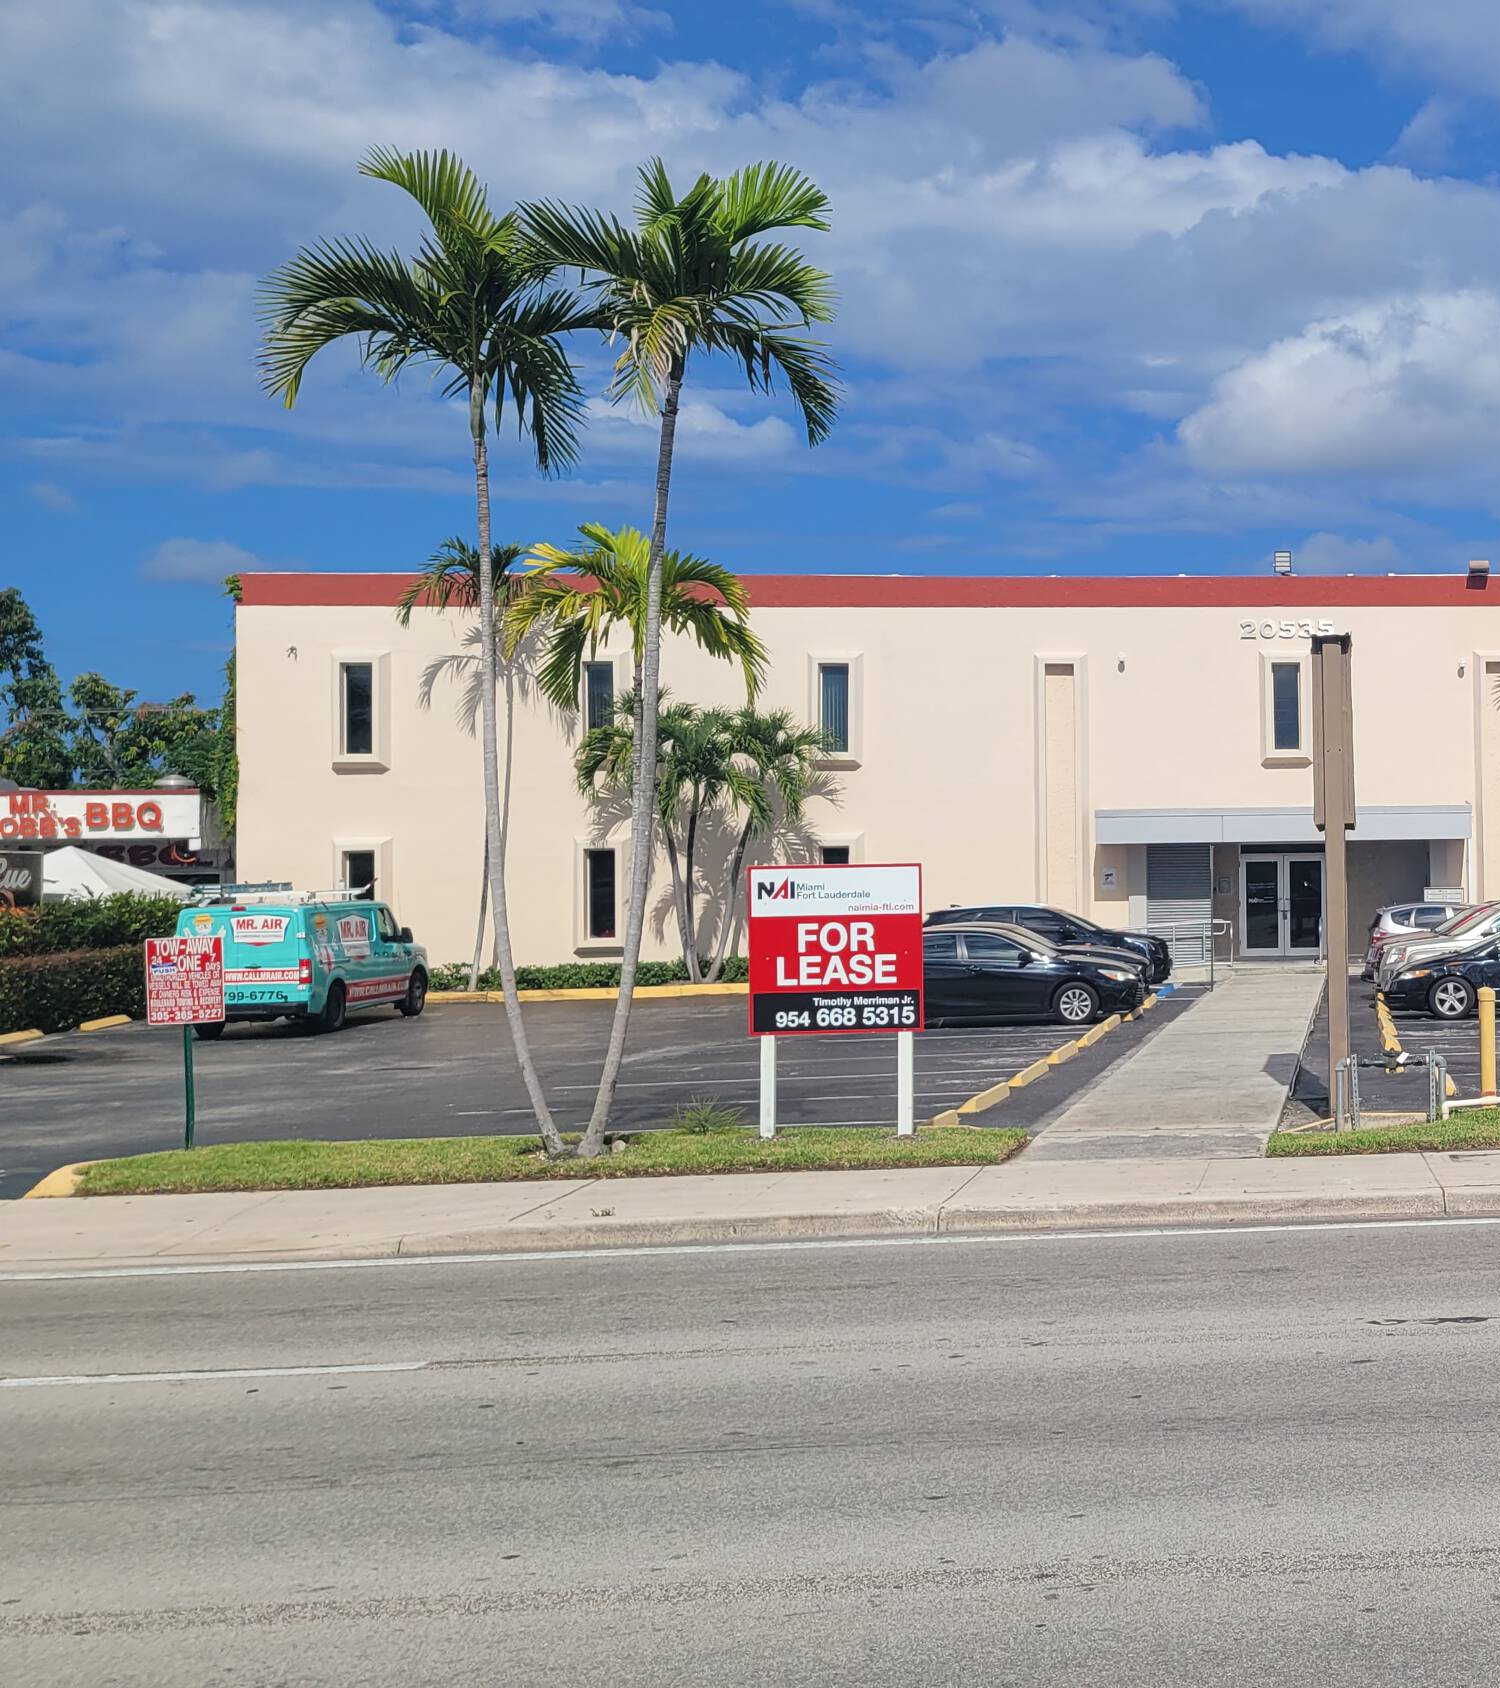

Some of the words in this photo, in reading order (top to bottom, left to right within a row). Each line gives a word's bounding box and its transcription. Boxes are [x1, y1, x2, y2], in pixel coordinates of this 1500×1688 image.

[1239, 618, 1335, 640] 20535
[86, 801, 164, 832] BBQ
[757, 876, 795, 899] NAI
[796, 883, 825, 891] Miami
[796, 891, 817, 899] Fort
[818, 890, 871, 899] Lauderdale
[848, 903, 914, 912] naimia-ftl.com
[236, 918, 257, 930] MR.
[261, 918, 283, 930] AIR
[154, 938, 214, 956] TOW-AWAY
[797, 922, 875, 953] FOR
[776, 954, 897, 987] LEASE
[812, 997, 852, 1007] Timothy
[854, 996, 899, 1006] Merriman
[901, 995, 914, 1005] Jr.
[775, 1011, 810, 1028] 954
[816, 1008, 856, 1026] 668
[862, 1006, 915, 1025] 5315
